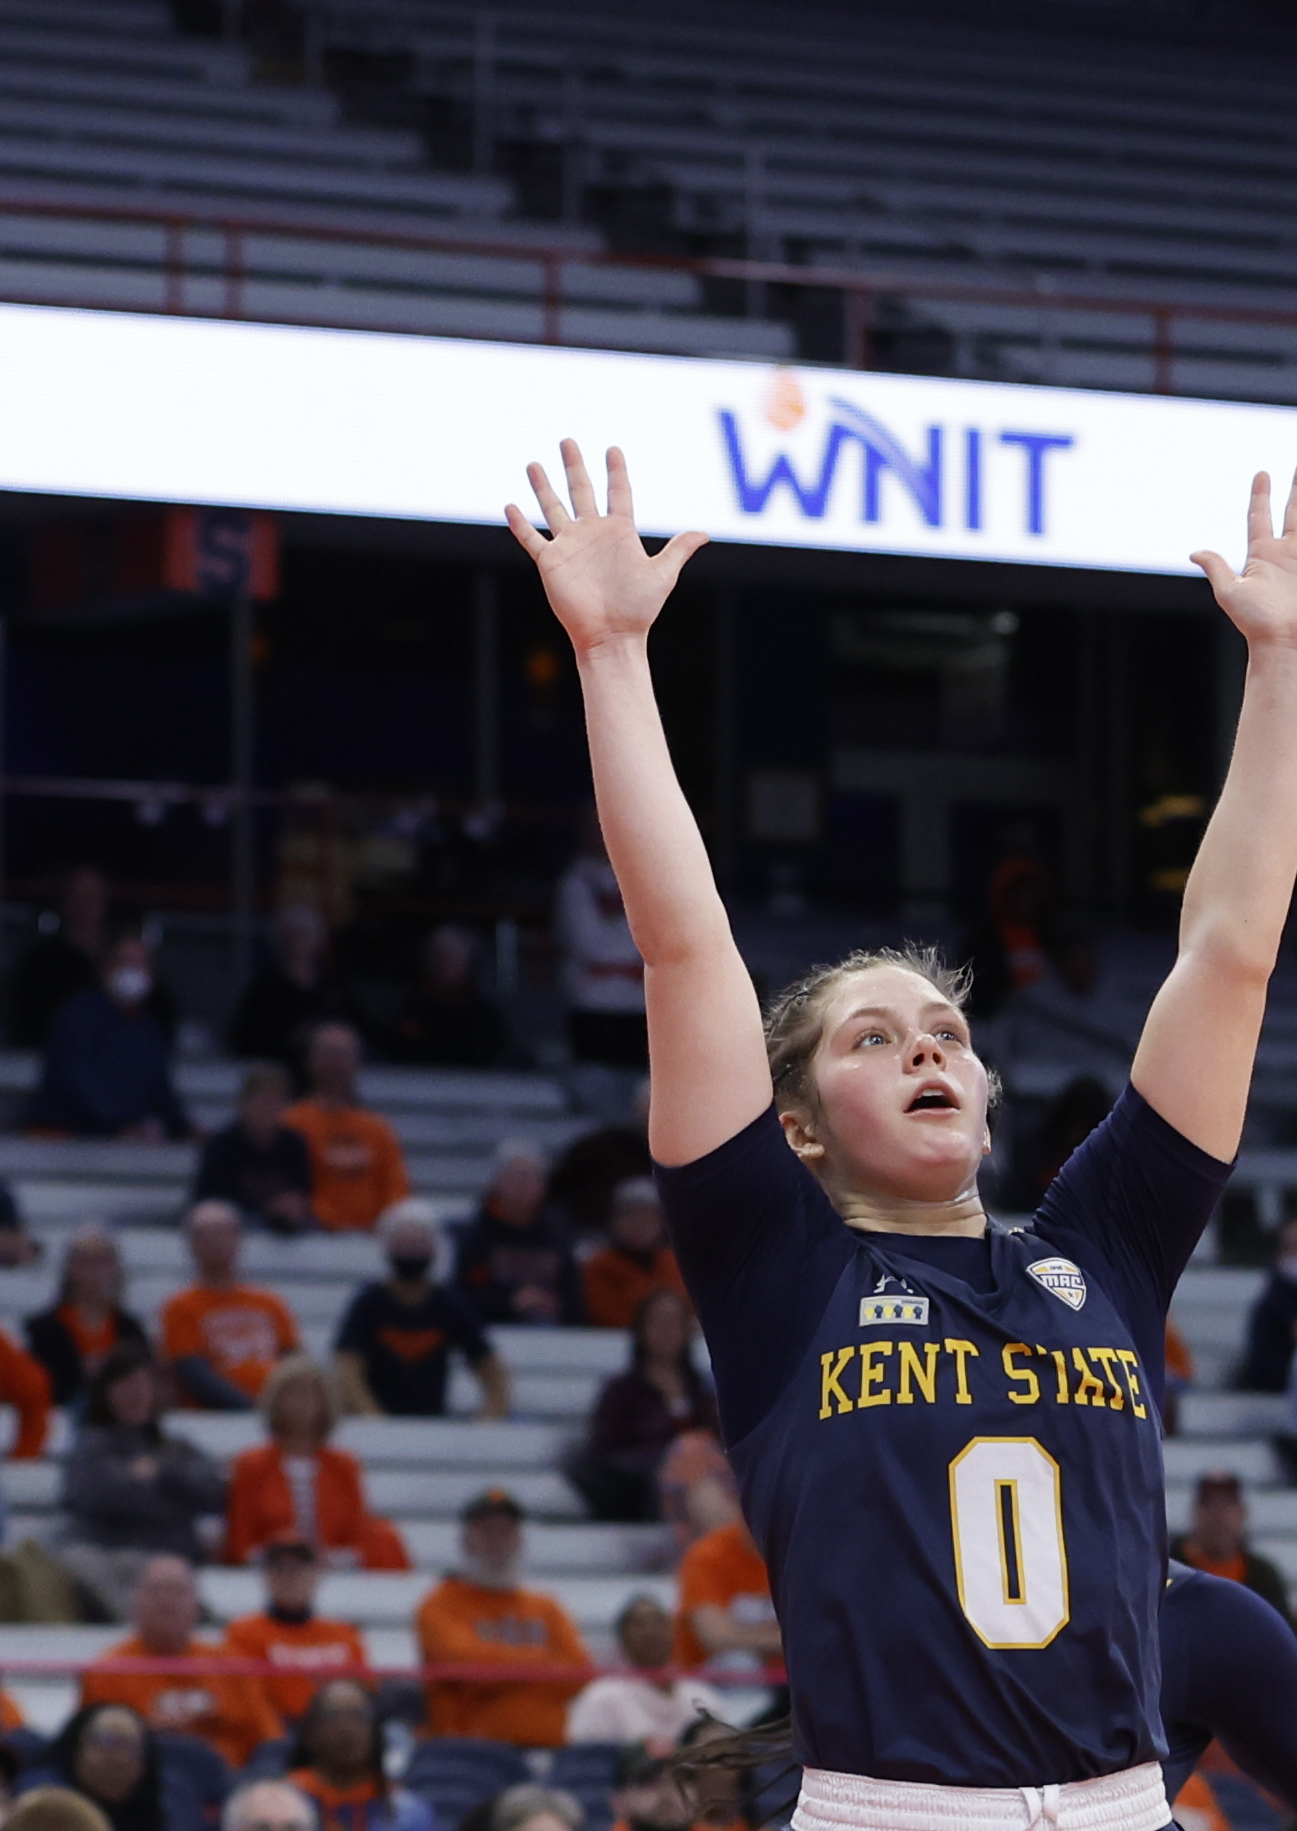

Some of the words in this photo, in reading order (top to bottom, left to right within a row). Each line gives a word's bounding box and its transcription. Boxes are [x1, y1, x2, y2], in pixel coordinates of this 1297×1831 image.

[720, 397, 1074, 535] WNIT
[1039, 1274, 1086, 1289] MAC
[819, 1338, 980, 1420] KENT
[1002, 1342, 1147, 1420] STATE
[948, 1436, 1070, 1650] 0
